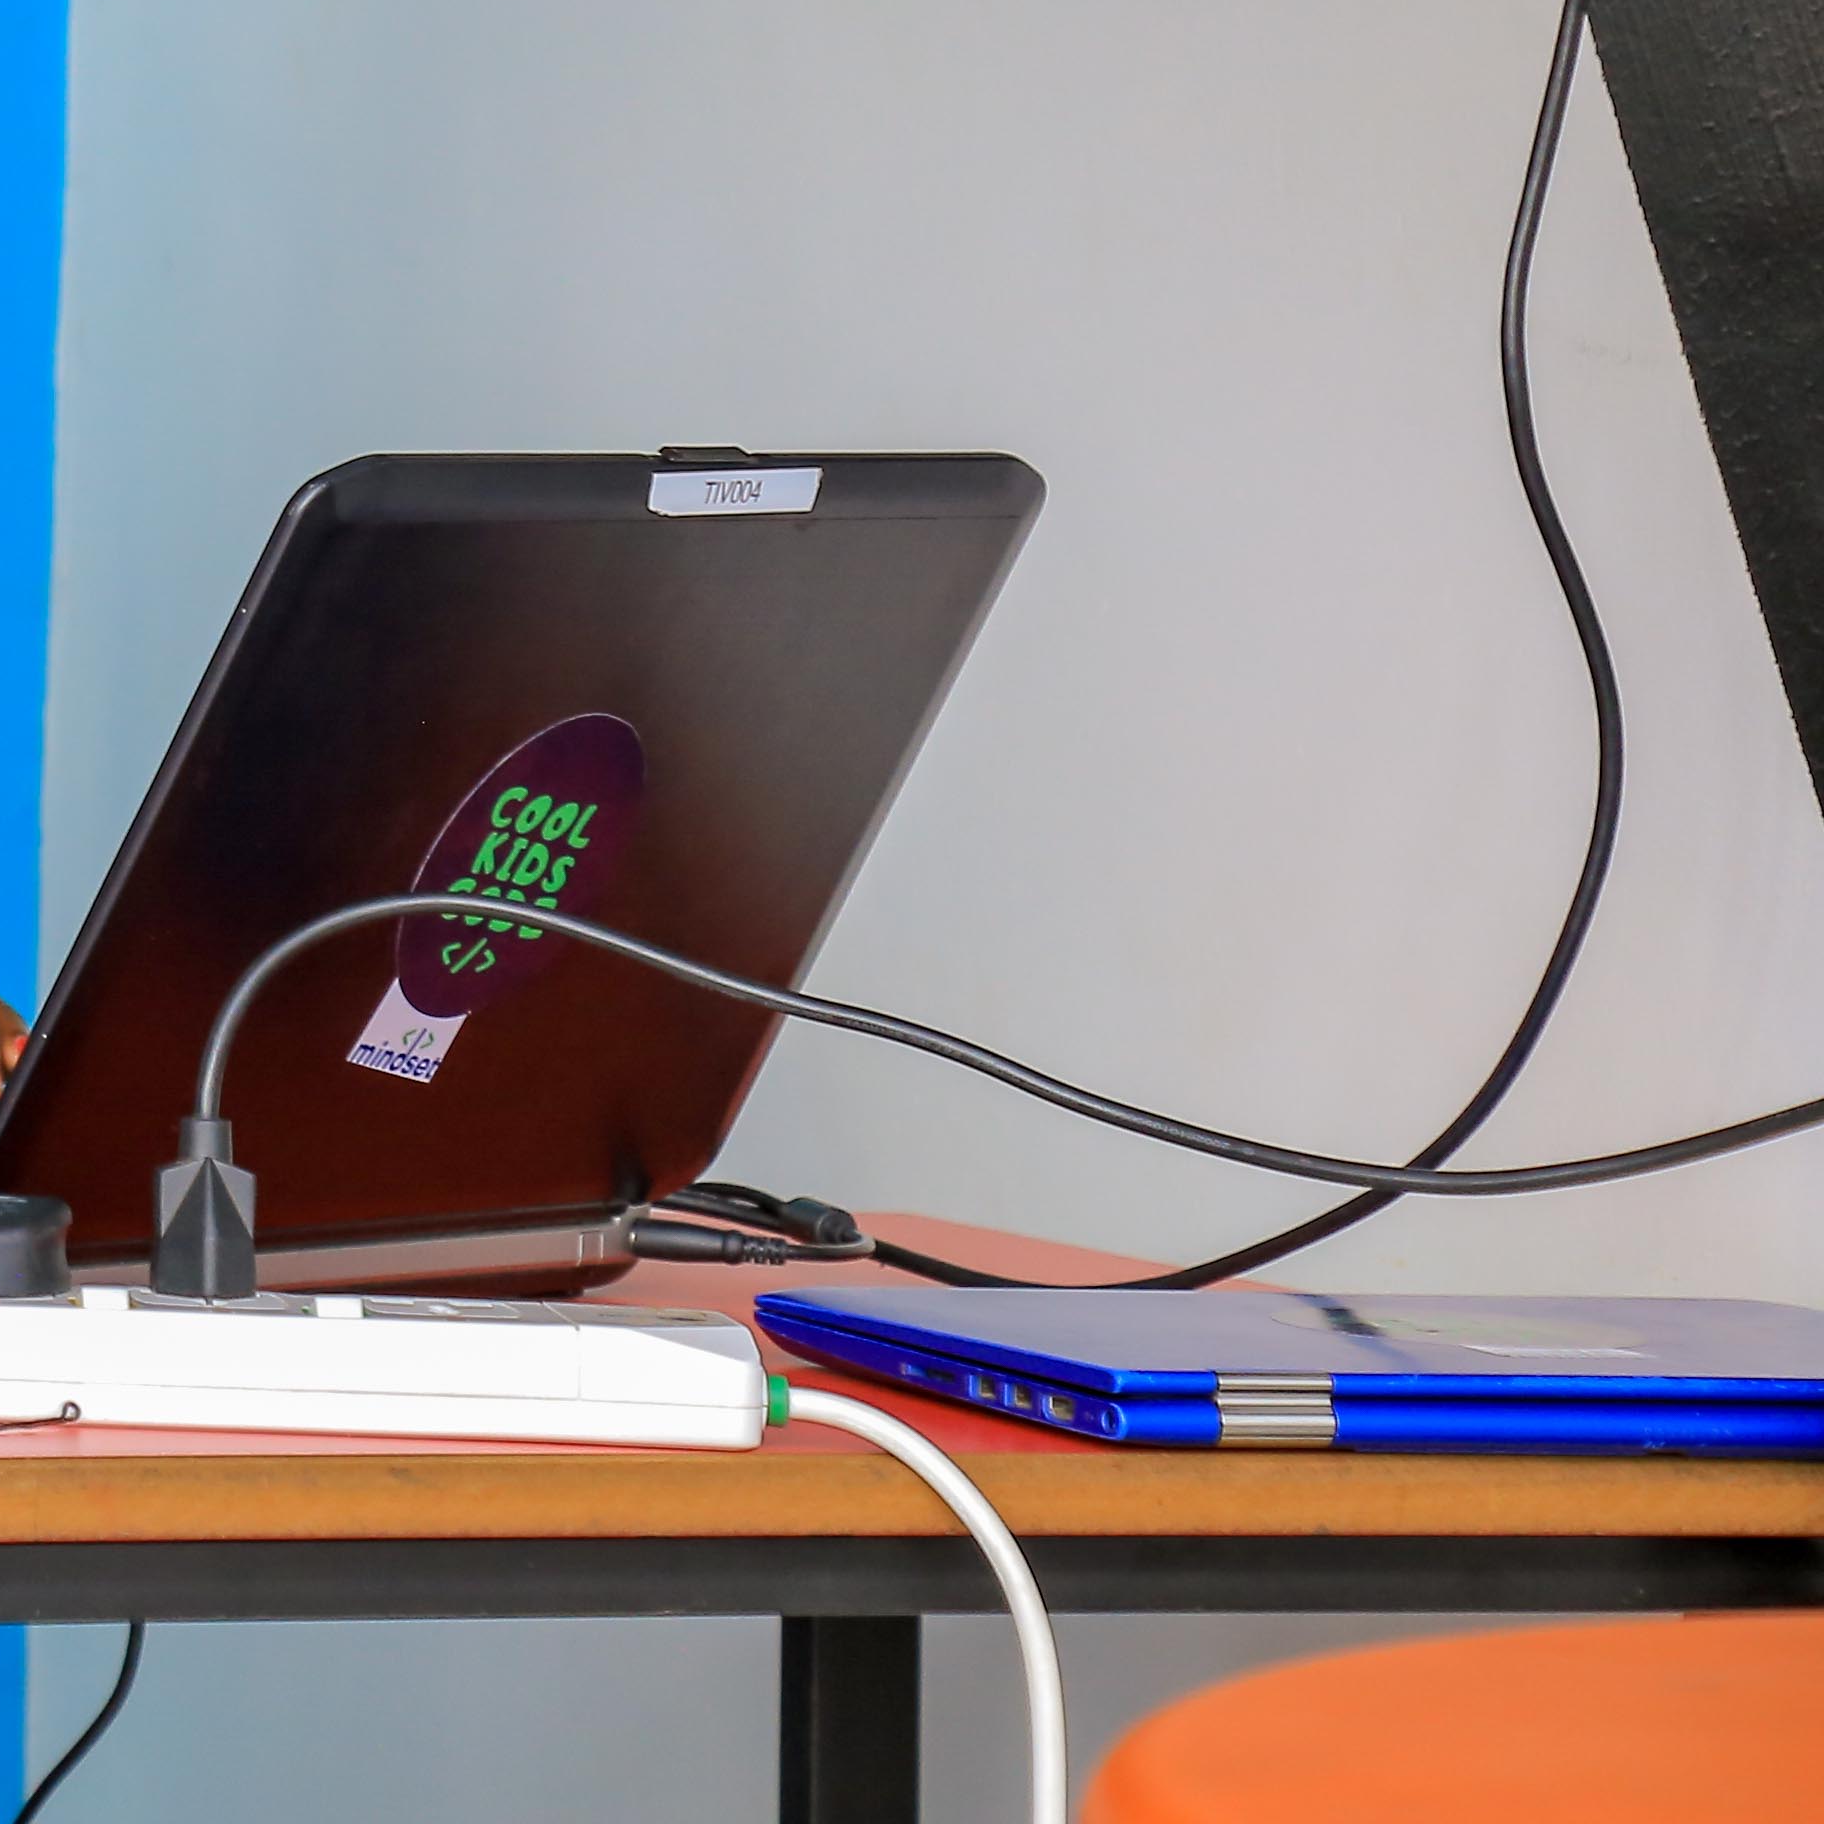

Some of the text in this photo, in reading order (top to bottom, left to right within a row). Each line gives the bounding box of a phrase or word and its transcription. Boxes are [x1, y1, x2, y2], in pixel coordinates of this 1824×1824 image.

[705, 479, 763, 504] TIV004
[491, 786, 598, 849] COOL
[471, 832, 576, 893] KIDS
[351, 1028, 441, 1079] mindset
